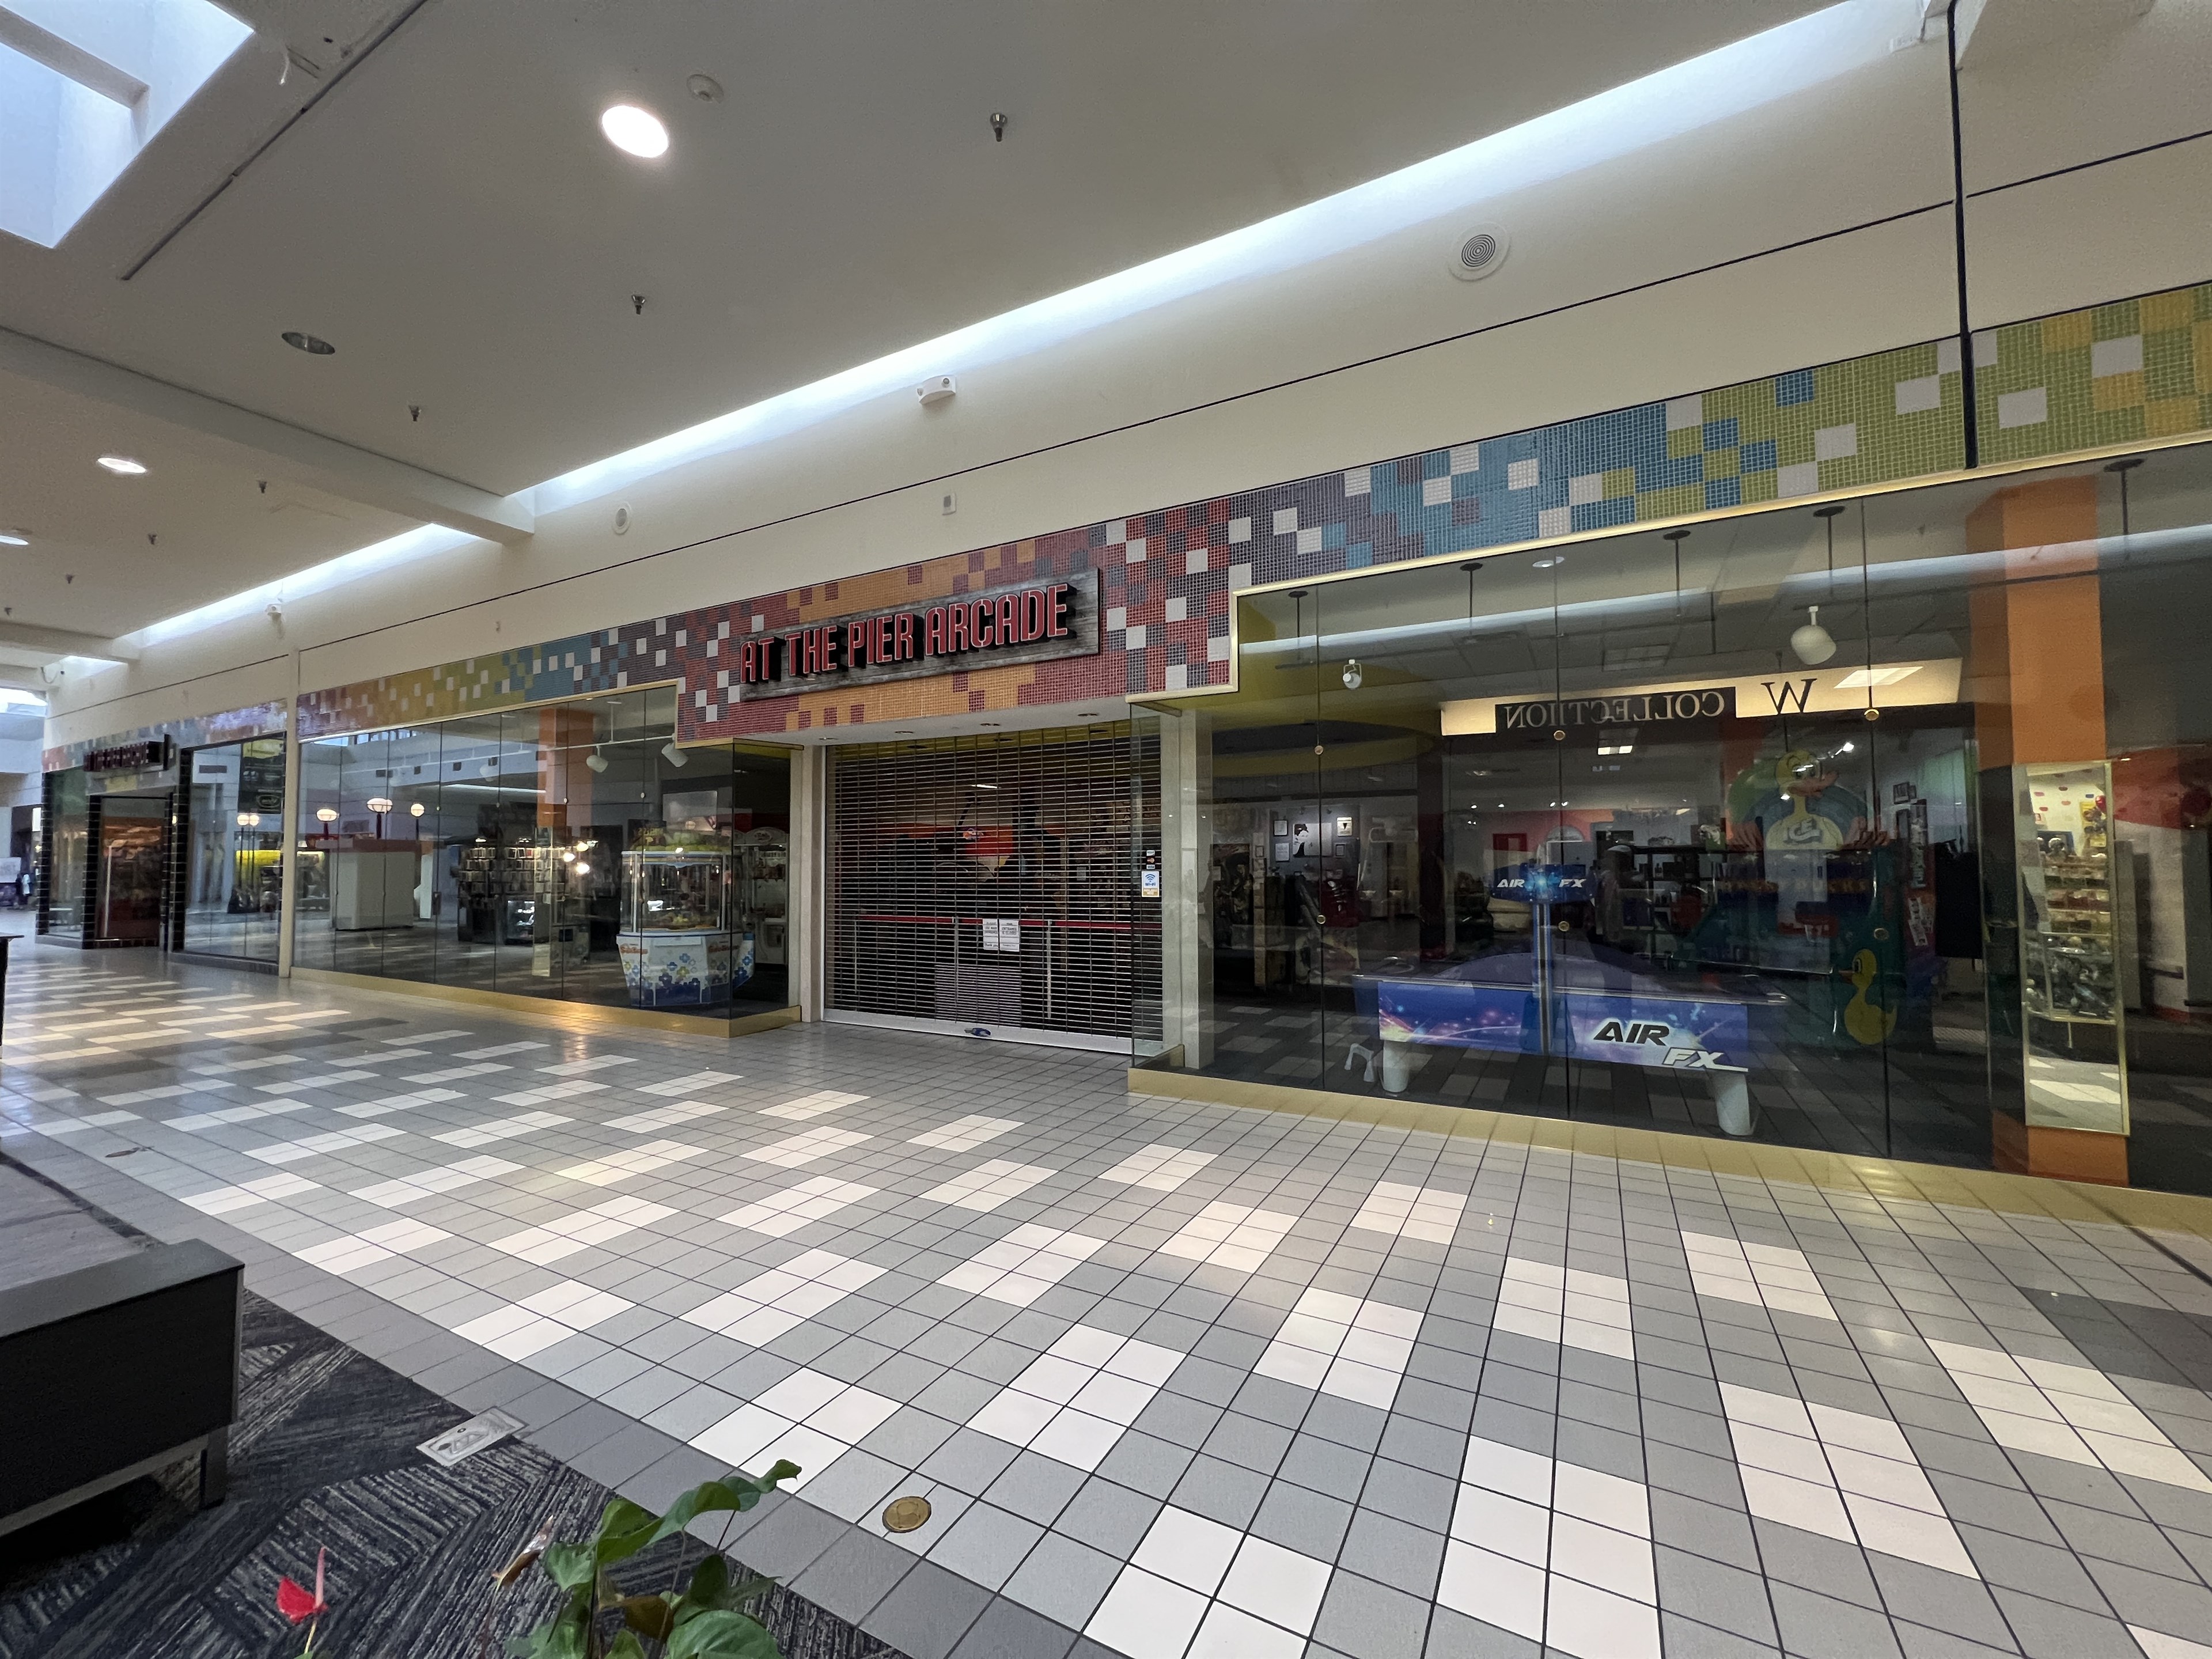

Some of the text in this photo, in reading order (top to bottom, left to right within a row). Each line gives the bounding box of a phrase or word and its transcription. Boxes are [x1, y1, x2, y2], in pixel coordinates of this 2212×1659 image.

[740, 583, 1067, 683] AT THE PIER ARCADE
[1497, 878, 1587, 888] AIR FX
[1593, 1022, 1669, 1046] AIR
[1662, 1047, 1748, 1072] FX
